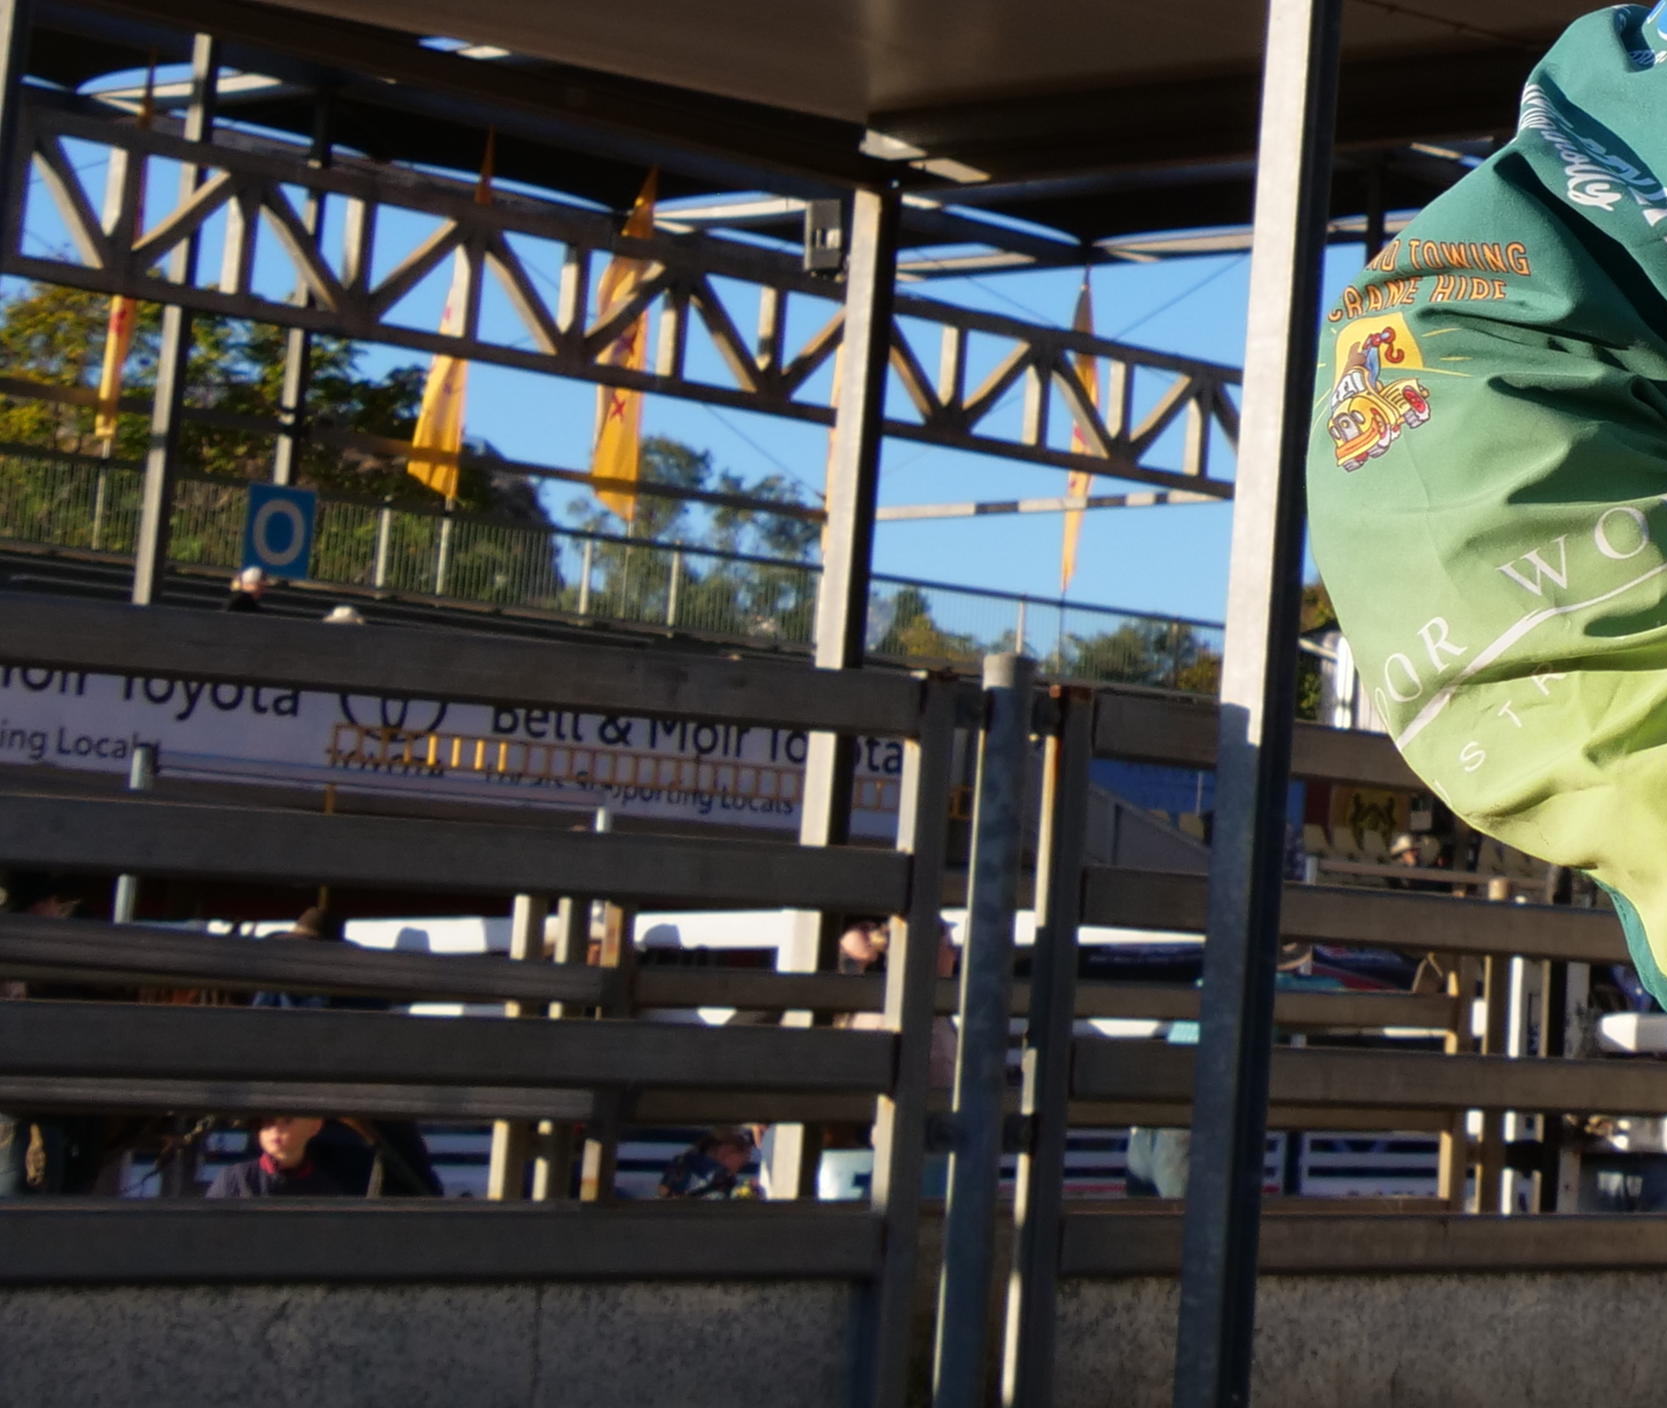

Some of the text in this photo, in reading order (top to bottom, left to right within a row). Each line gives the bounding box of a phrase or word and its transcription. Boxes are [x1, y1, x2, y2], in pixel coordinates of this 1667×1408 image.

[1409, 239, 1531, 277] TOWING
[57, 726, 143, 760] Local
[771, 730, 903, 776] Tota
